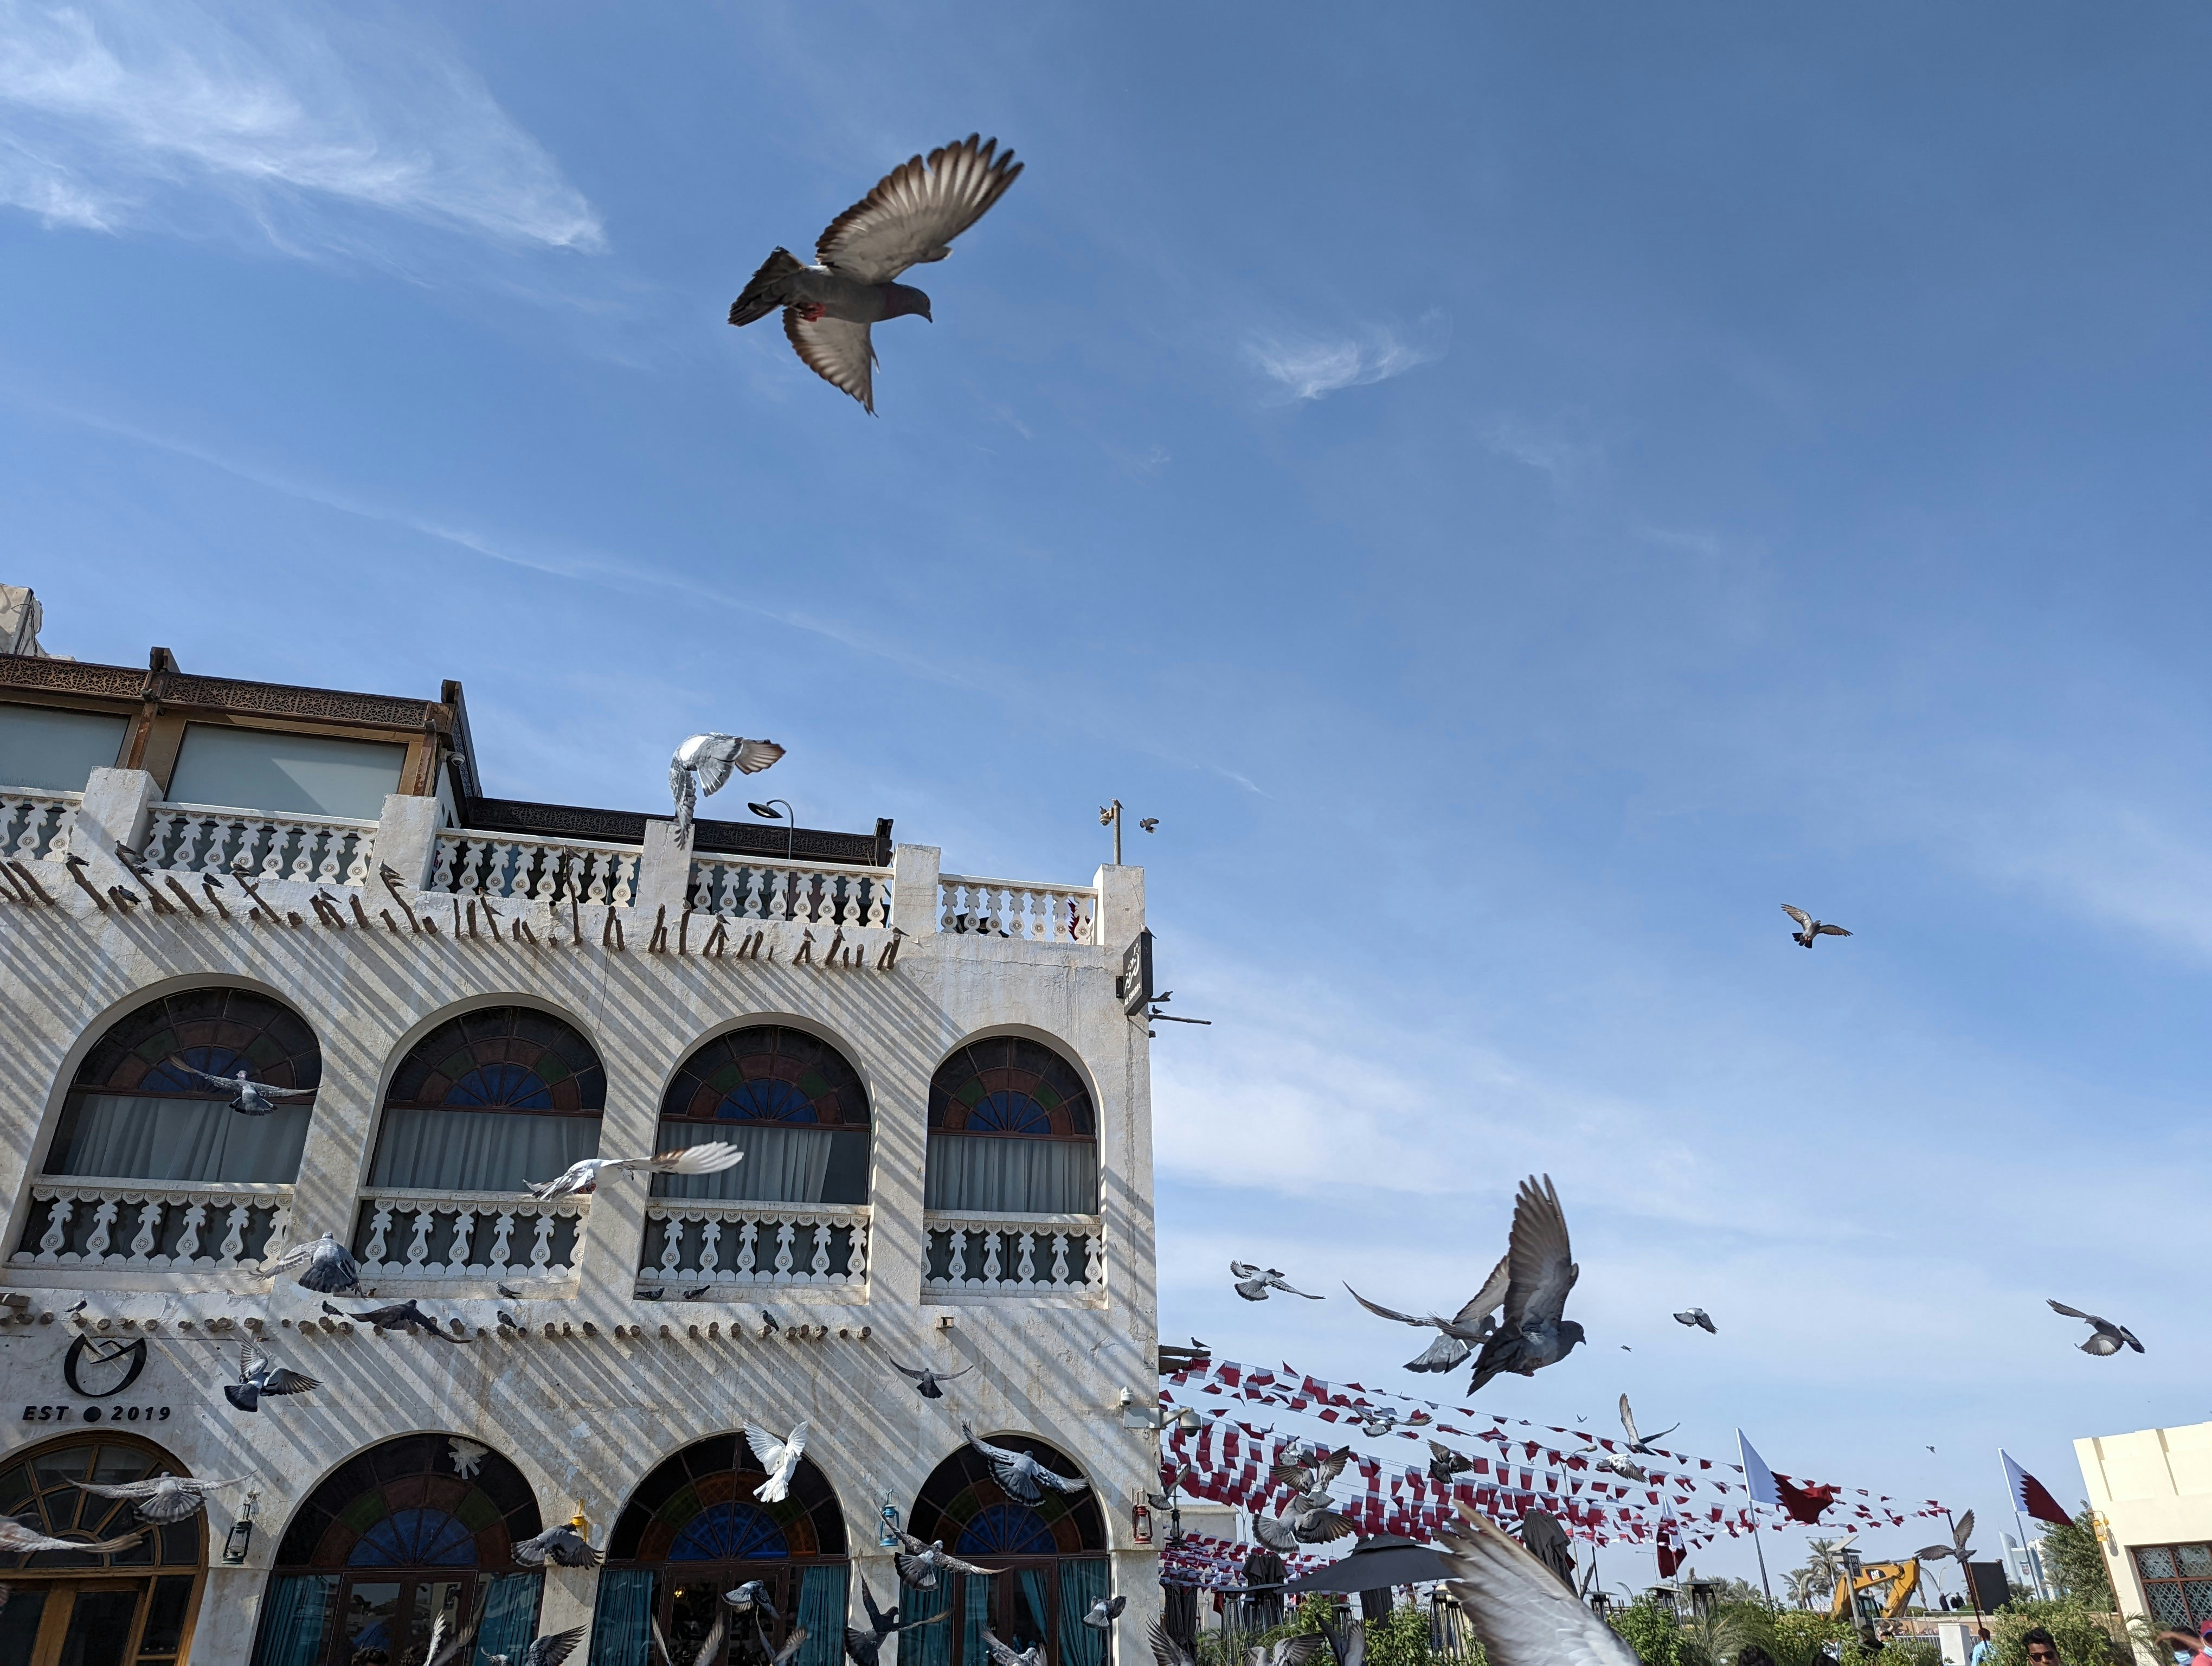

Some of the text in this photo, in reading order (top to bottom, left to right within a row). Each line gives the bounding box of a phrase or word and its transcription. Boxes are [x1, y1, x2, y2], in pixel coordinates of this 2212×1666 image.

[1124, 997, 1129, 1007] AL
[22, 1406, 170, 1421] EST 2019
[1871, 1569, 1880, 1580] CAT
